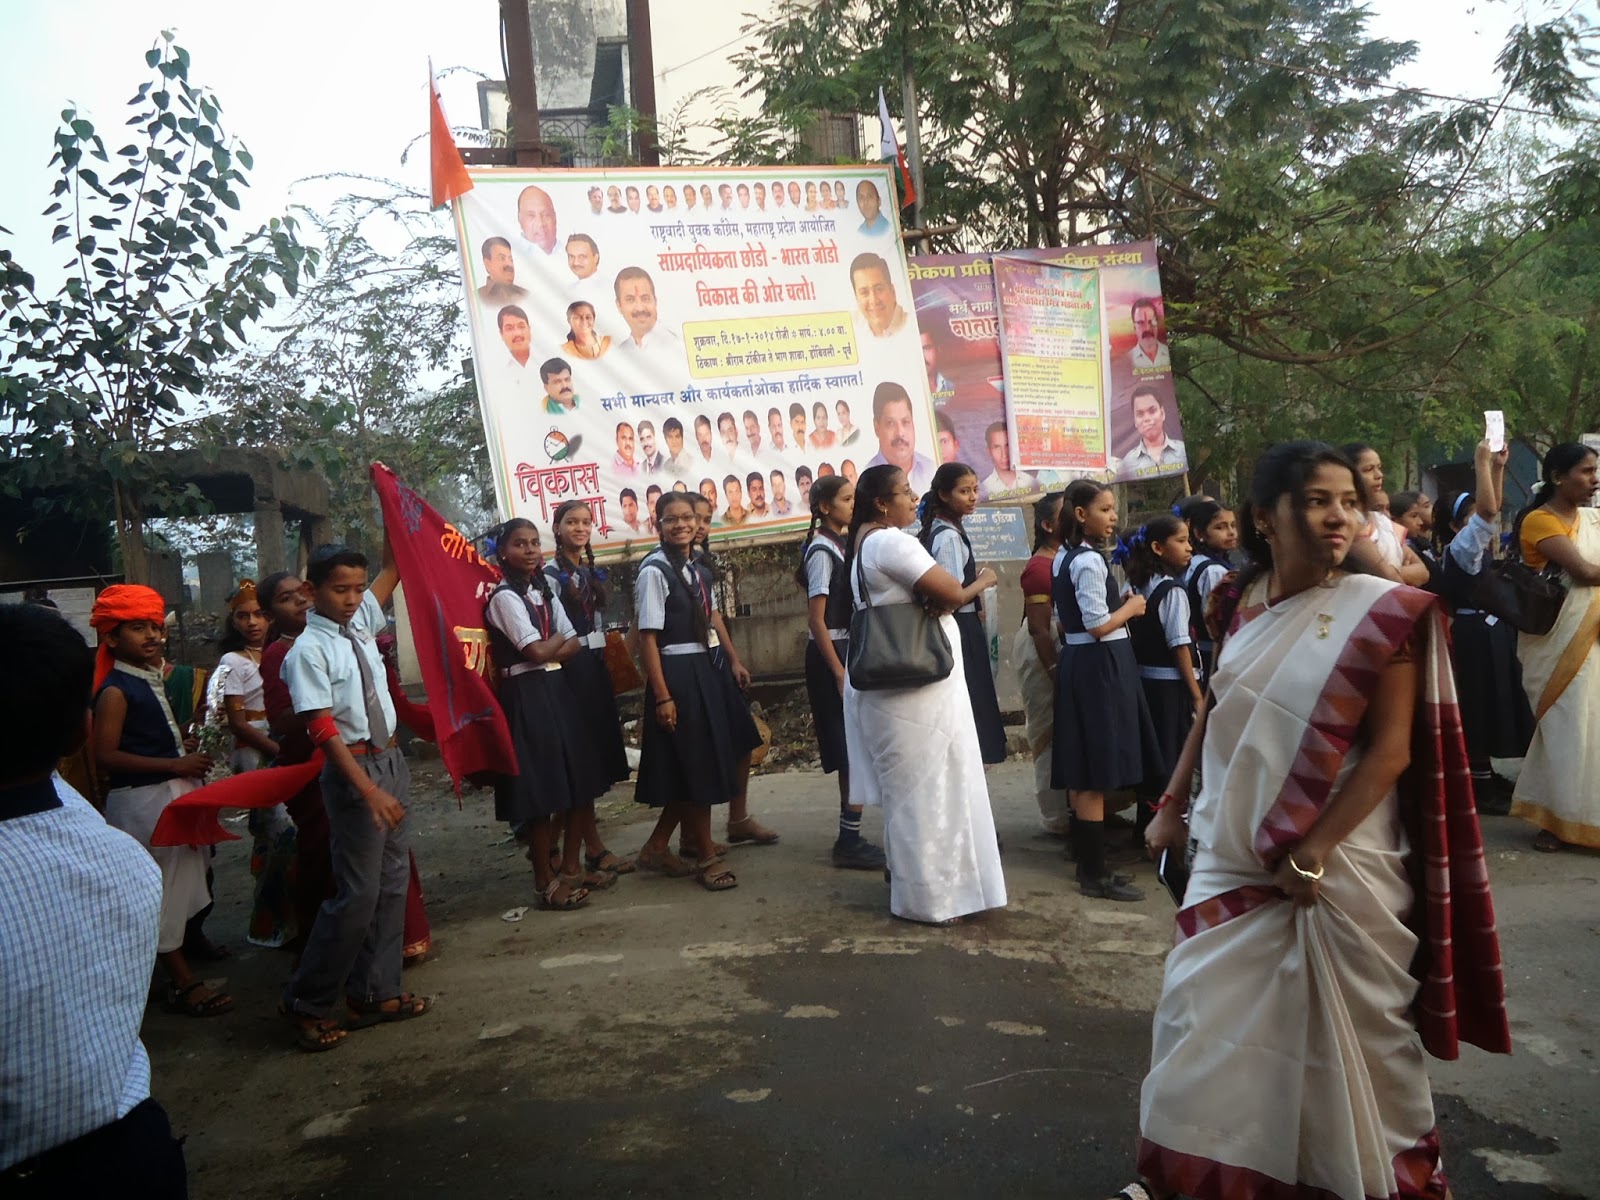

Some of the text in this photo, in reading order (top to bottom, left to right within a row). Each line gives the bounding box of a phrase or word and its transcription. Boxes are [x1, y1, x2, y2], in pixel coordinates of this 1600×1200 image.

[650, 220, 685, 243] राष्ट्रवादी
[687, 225, 711, 244] युवक
[746, 221, 776, 239] महाराष्ट्र
[777, 217, 797, 236] प्रदेश
[799, 214, 836, 234] आयोजित
[657, 243, 738, 273] सांप्रदायिकता
[739, 242, 768, 268] छोडो
[780, 246, 810, 266] भारत
[812, 238, 839, 264] जोडो
[1103, 250, 1142, 266] संस्था
[695, 275, 817, 307] विकास की ओर चलो!
[725, 352, 744, 367] श्रीराम
[600, 371, 864, 412] सभी मान्यवर और कार्यकर्ताओका हार्दिक स्वागत!
[514, 462, 600, 523] विकास
